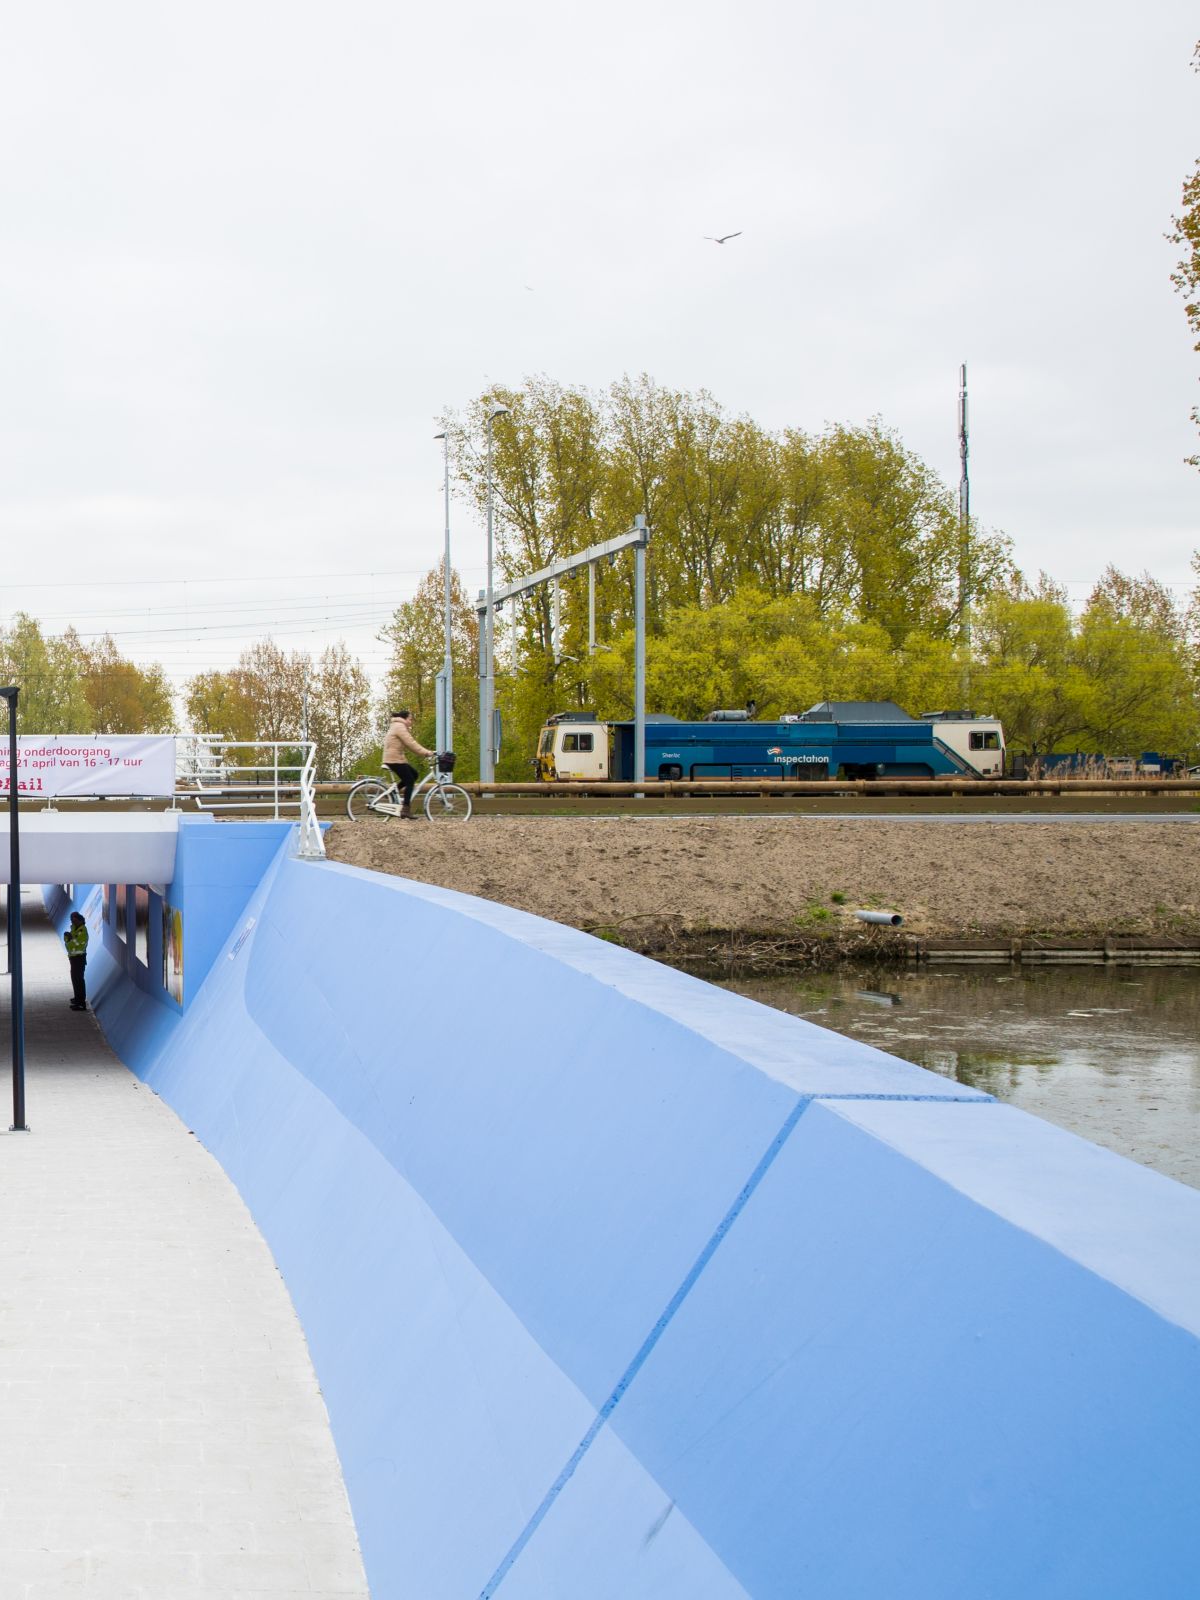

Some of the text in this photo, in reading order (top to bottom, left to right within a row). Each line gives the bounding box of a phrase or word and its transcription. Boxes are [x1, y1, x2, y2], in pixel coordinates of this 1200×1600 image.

[24, 747, 111, 758] onderdoorgang
[16, 759, 28, 768] 21
[32, 757, 56, 769] april
[60, 759, 80, 767] van
[85, 759, 97, 767] 16
[108, 758, 120, 766] 17
